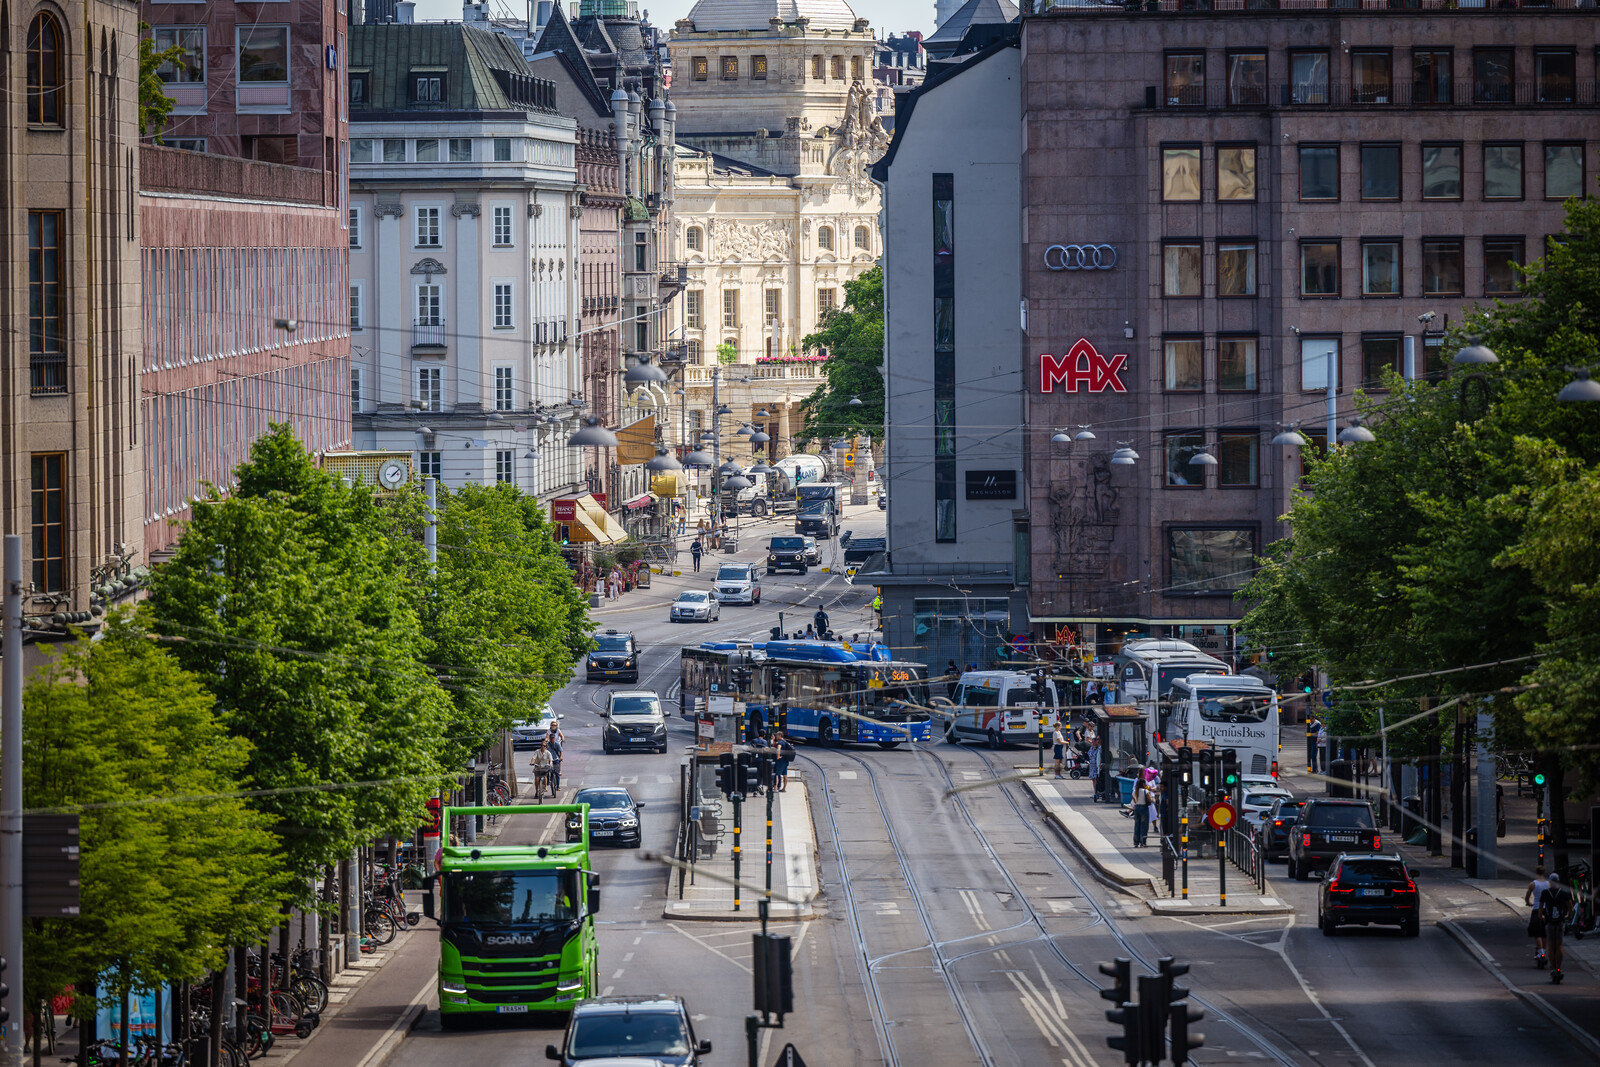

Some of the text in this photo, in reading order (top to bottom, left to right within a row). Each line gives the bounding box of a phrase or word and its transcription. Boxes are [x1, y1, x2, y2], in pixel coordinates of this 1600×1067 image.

[1040, 337, 1128, 393] MAX
[1056, 624, 1076, 645] MAX
[1192, 628, 1205, 636] JUST
[874, 670, 909, 681] 2 Sofia
[487, 935, 535, 945] SCANIA
